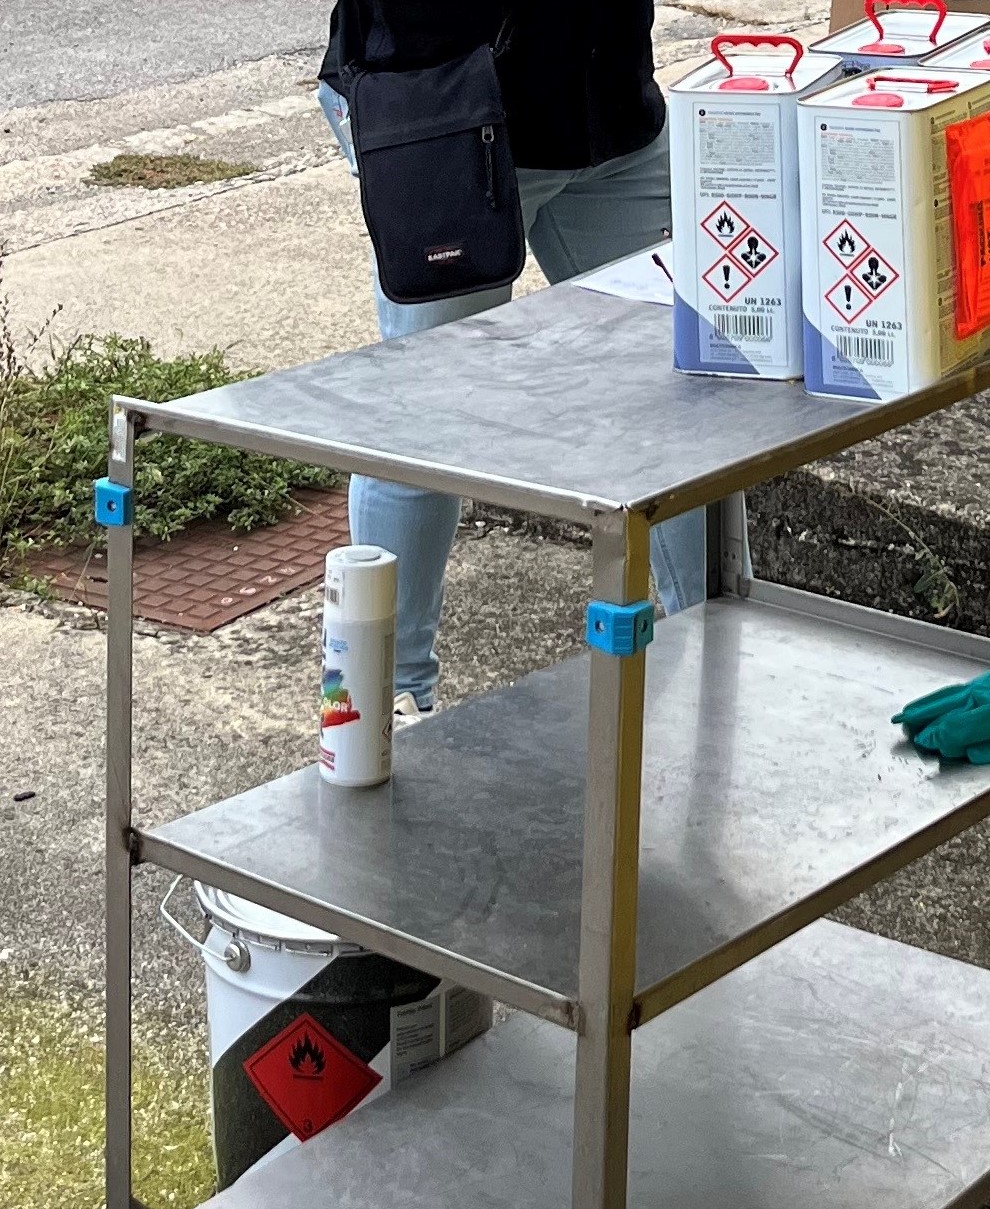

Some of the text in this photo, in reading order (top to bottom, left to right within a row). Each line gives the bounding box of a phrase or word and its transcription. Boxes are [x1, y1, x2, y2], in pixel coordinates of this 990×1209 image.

[744, 297, 782, 306] UN 1263
[865, 319, 903, 331] UN 1263
[303, 1118, 314, 1134] 3
